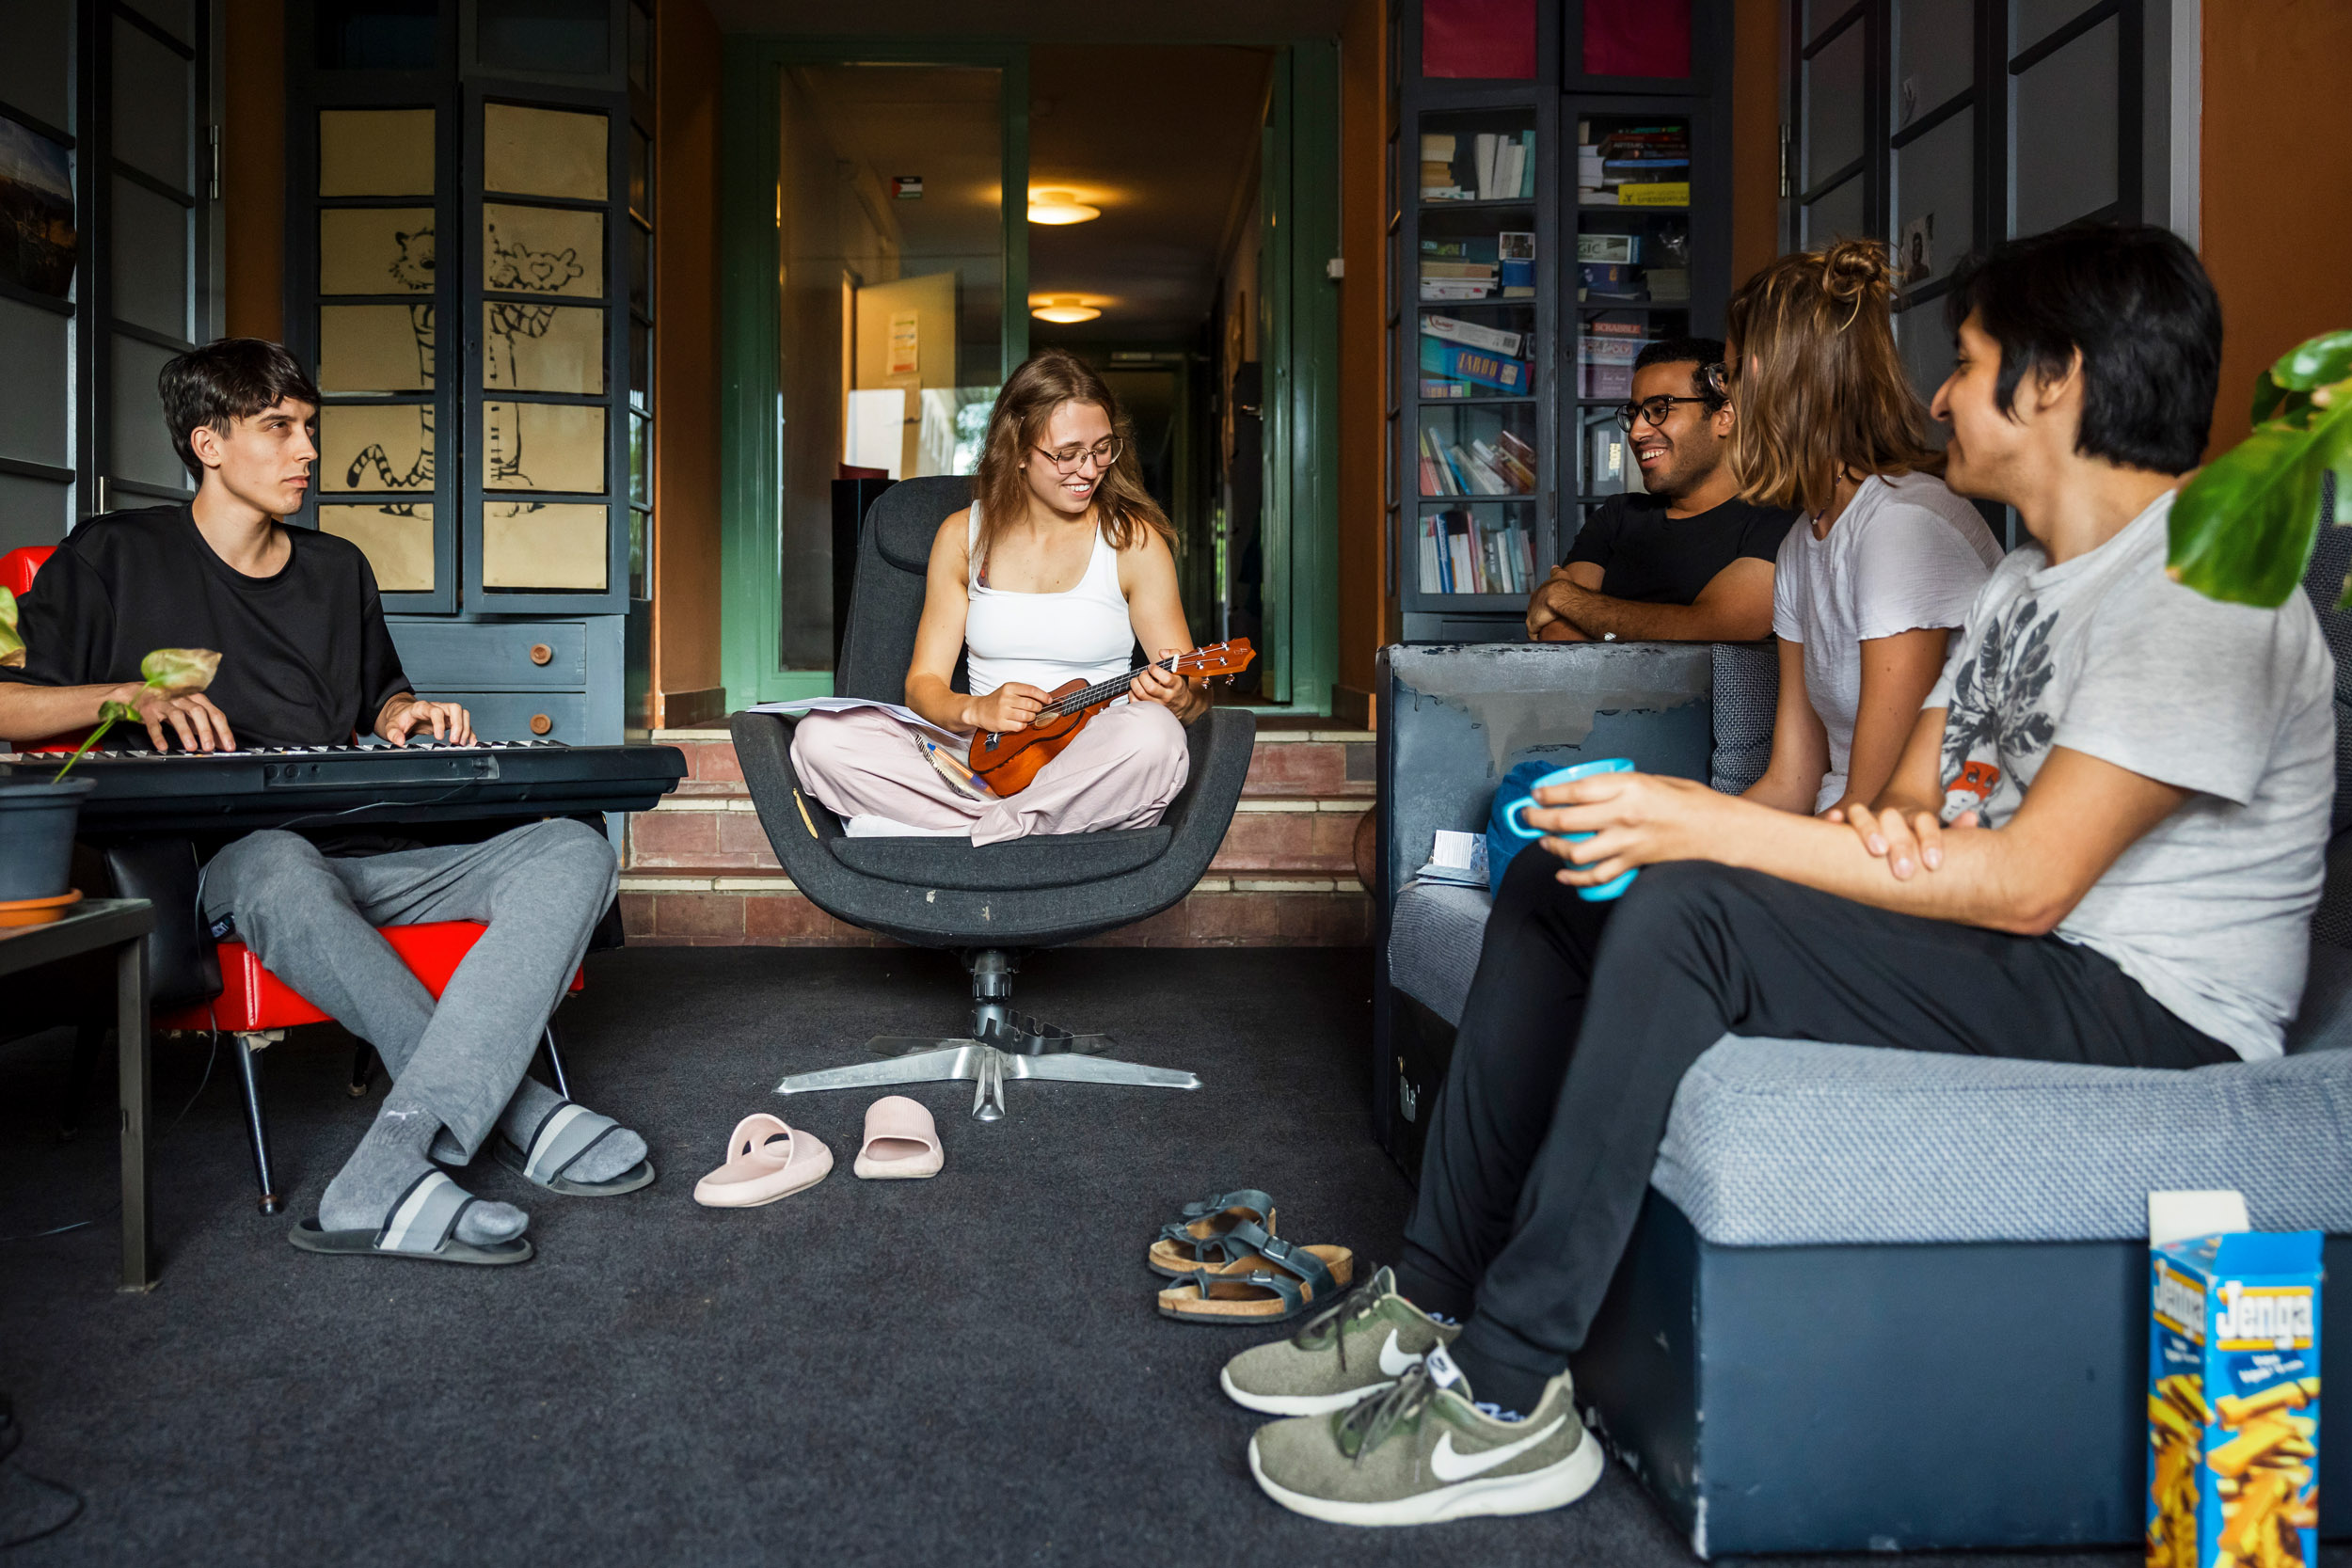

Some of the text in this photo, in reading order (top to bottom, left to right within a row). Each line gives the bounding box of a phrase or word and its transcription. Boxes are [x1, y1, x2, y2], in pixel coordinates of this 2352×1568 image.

[1595, 323, 1641, 334] SCRABBLE
[2153, 1258, 2205, 1339] Jenga
[2216, 1280, 2312, 1350] Jenga
